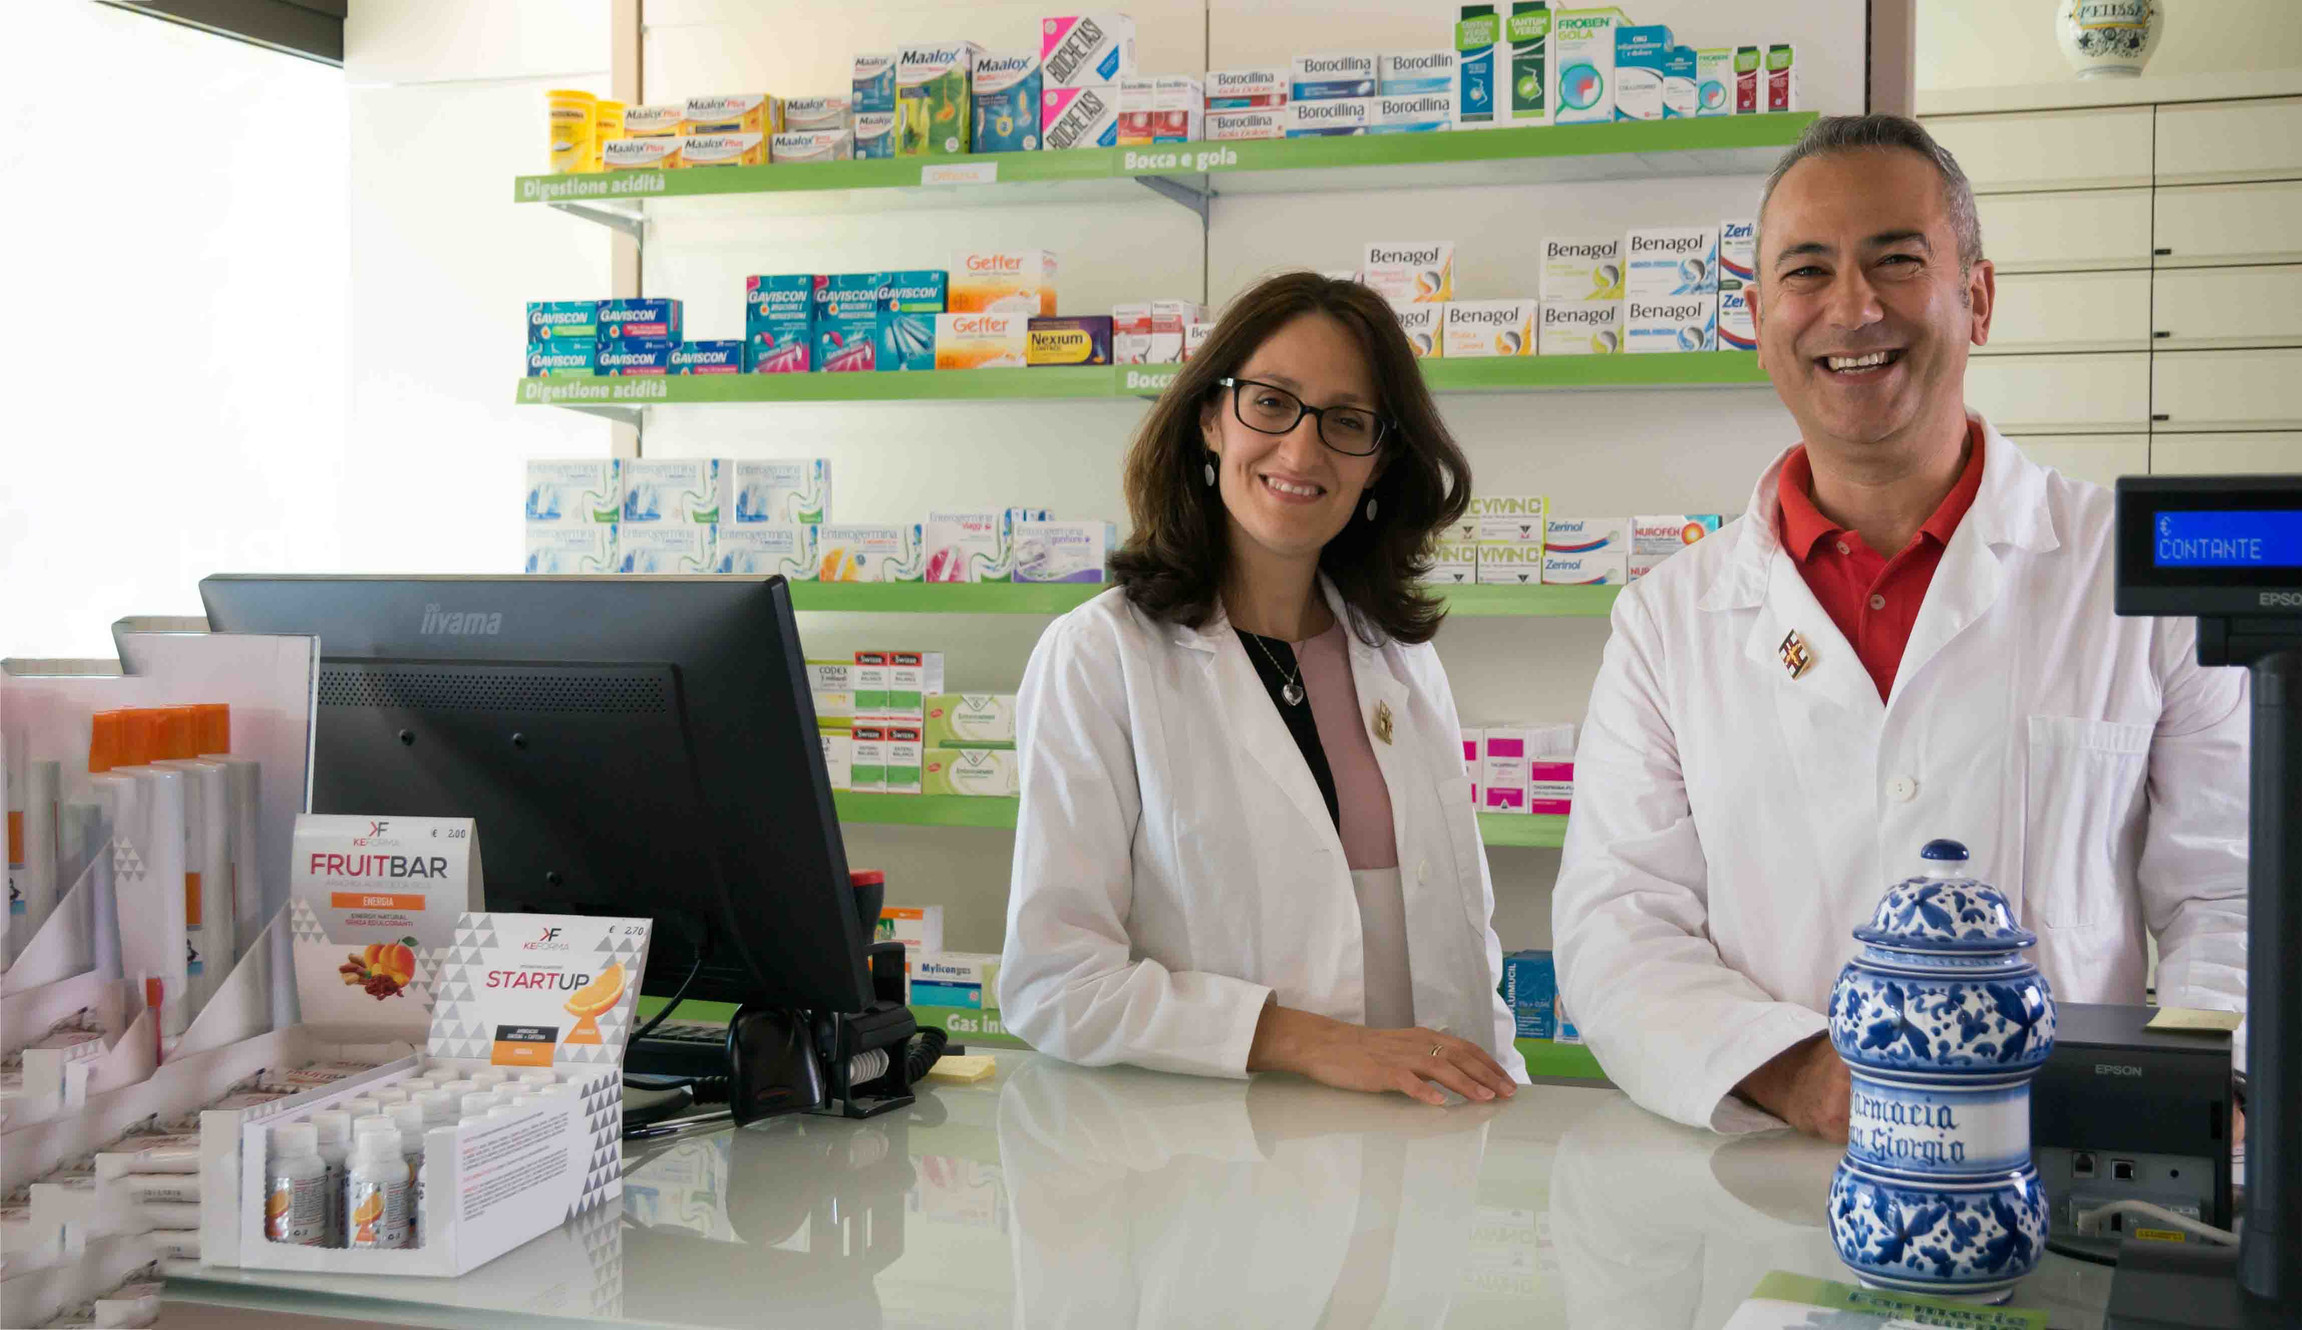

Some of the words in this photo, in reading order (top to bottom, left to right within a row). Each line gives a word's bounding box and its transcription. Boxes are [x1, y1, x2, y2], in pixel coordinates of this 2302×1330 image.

[1558, 17, 1611, 29] FROBEN
[1559, 30, 1595, 40] GOLA
[900, 48, 960, 66] Maalox
[1046, 17, 1104, 84] BIOCHETASI
[855, 57, 889, 67] Maalox
[976, 55, 1031, 73] Maalox
[1304, 56, 1372, 73] Borocillina
[1393, 51, 1453, 71] Borocillin
[1218, 72, 1275, 86] Borocillina
[688, 98, 726, 110] Maalox
[727, 99, 747, 109] Plus
[787, 98, 827, 111] Maalox
[1299, 101, 1365, 119] Borocillina
[1382, 97, 1451, 116] Borocillina
[627, 109, 662, 120] Maalox
[663, 109, 682, 118] Plus
[859, 116, 894, 126] Maalox
[1217, 114, 1273, 128] Borocillina
[685, 137, 725, 150] Maalox
[725, 138, 744, 149] Plus
[774, 133, 814, 147] Maalox
[606, 142, 644, 154] Maalox
[645, 142, 666, 153] Plus
[1125, 151, 1177, 170] Bocca
[1181, 151, 1192, 164] e
[1196, 146, 1238, 171] gola
[523, 178, 608, 201] Digestione
[611, 173, 666, 194] acidità
[1547, 240, 1618, 259] Benagol
[1631, 234, 1704, 253] Benagol
[967, 254, 1024, 271] Geffer
[1370, 247, 1440, 266] Benagol
[749, 290, 807, 303] GAVISCON
[817, 289, 877, 303] GAVISCON
[879, 286, 938, 300] GAVISCON
[1723, 294, 1745, 308] Zer
[601, 309, 656, 323] GAVISCON
[1450, 307, 1519, 326] Benagol
[1545, 305, 1615, 325] Benagol
[1630, 301, 1702, 320] Benagol
[532, 312, 588, 324] GAVISCON
[953, 317, 1010, 333] Geffer
[1400, 309, 1430, 328] agol
[1032, 332, 1084, 346] Nexium
[531, 354, 586, 367] GAVISCON
[601, 352, 656, 366] GAVISCON
[671, 352, 728, 364] GAVISCON
[525, 380, 610, 402] Digestione
[613, 378, 667, 399] acidità
[1527, 499, 1542, 514] C
[929, 511, 994, 526] Enterogermina
[1548, 520, 1584, 533] Zerinol
[1635, 528, 1680, 538] NUROFEN
[719, 528, 794, 543] Enterogermina
[821, 527, 898, 544] Enterogermina
[1526, 546, 1540, 561] C
[2159, 538, 2263, 560] CONTANTE
[1545, 558, 1581, 571] Zerinol
[1630, 567, 1651, 577] NUR
[2260, 592, 2302, 606] EPSO
[421, 603, 502, 635] iiyama
[860, 655, 883, 664] Swisse
[895, 655, 917, 664] Swisse
[819, 666, 848, 675] CODEX
[857, 730, 880, 739] Swisse
[892, 731, 915, 740] Swisse
[310, 853, 448, 879] FRUITBAR
[363, 896, 394, 907] ENERGIA
[522, 942, 570, 950] KEFORMA
[921, 963, 971, 976] Mylicongas
[486, 970, 590, 990] STARTUP
[947, 1014, 979, 1033] Gas
[2095, 1064, 2142, 1077] EPSON
[1850, 1127, 1865, 1149] an
[1867, 1127, 1966, 1168] Giorgio
